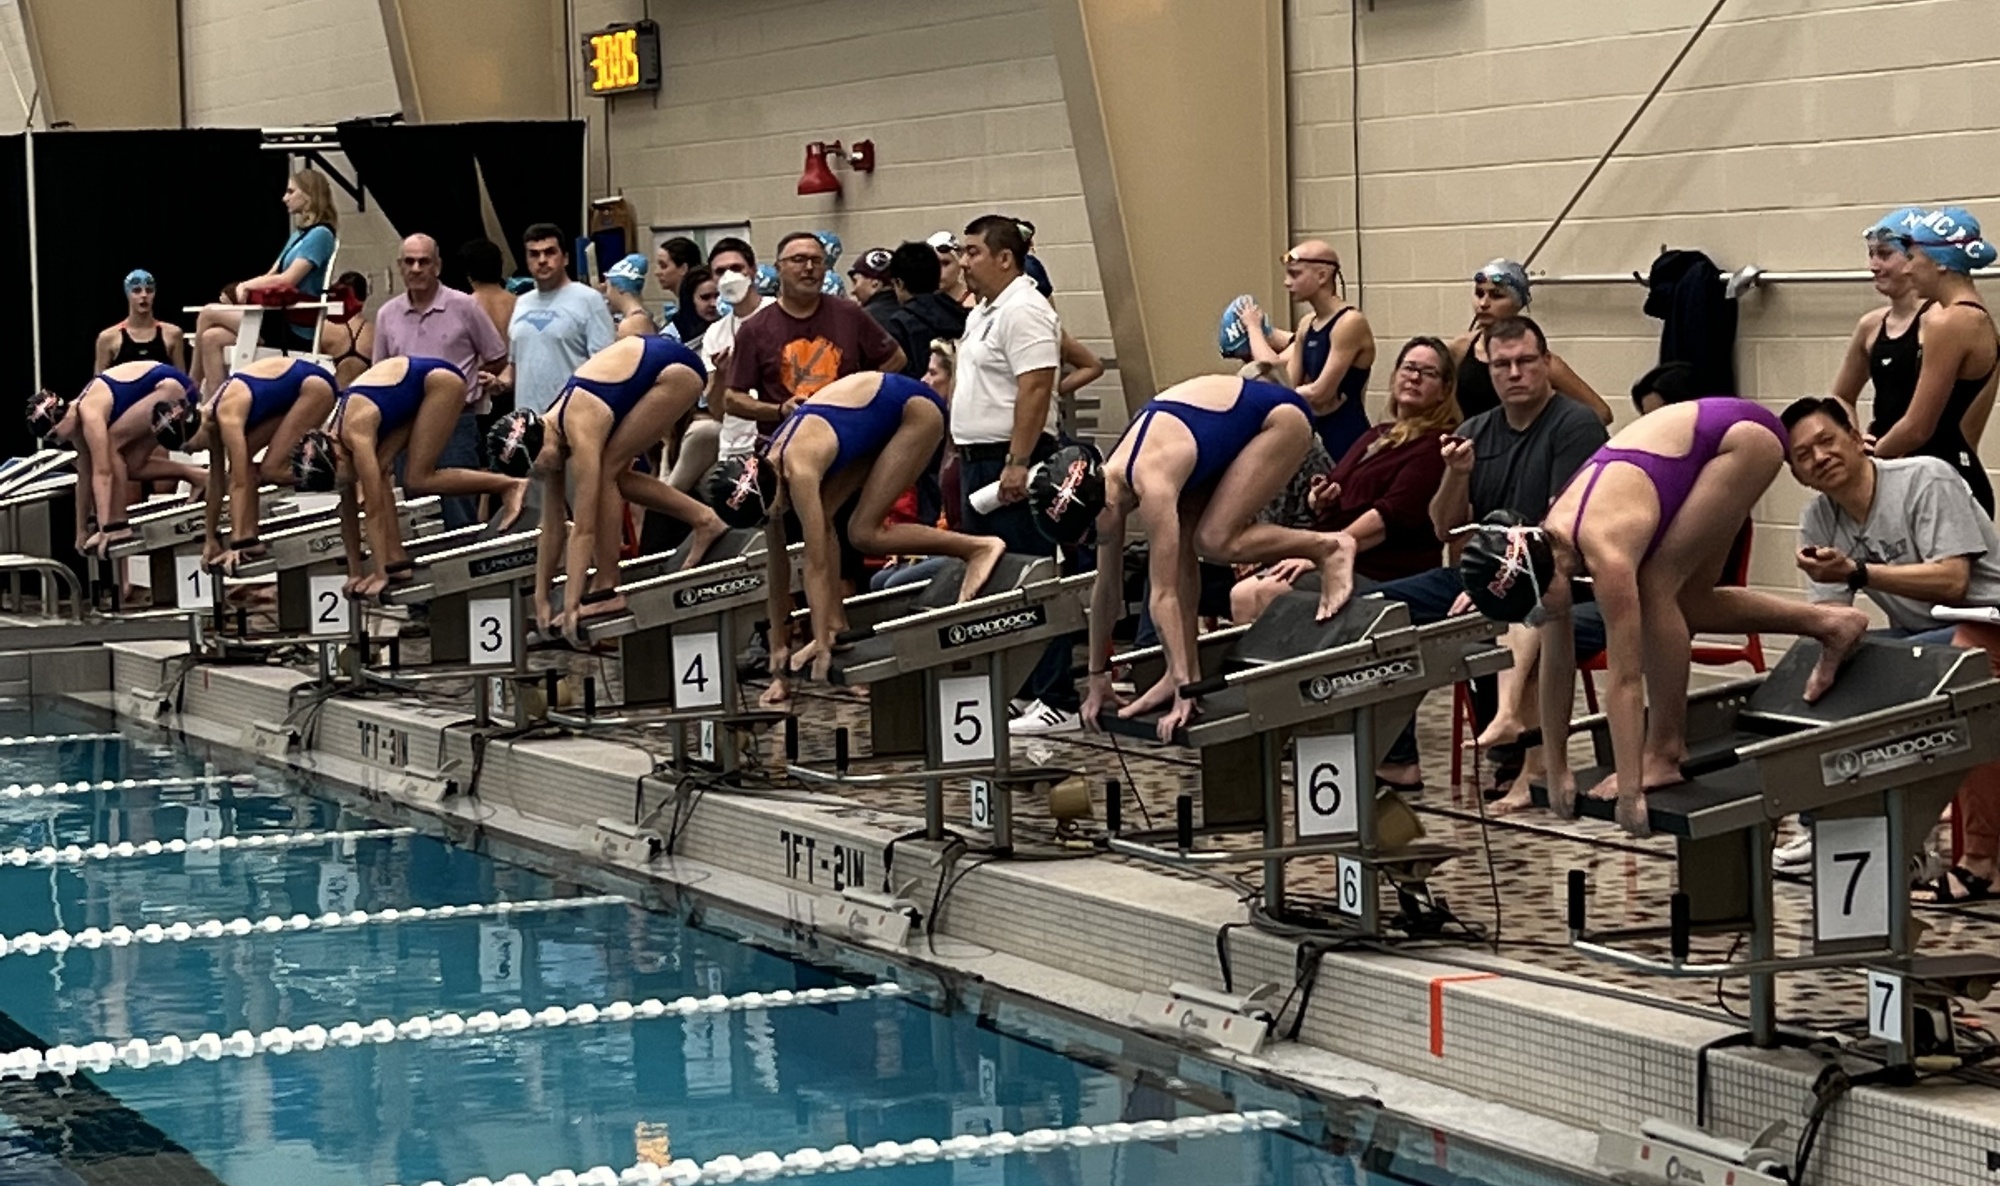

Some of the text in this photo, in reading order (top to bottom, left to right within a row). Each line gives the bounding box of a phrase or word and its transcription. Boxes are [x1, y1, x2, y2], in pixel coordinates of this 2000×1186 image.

[187, 569, 200, 598] 1
[697, 576, 760, 597] PADDOCK
[318, 591, 340, 624] 2
[967, 611, 1038, 637] PADDOCK
[479, 616, 503, 653] 3
[681, 653, 709, 693] 4
[1331, 660, 1413, 689] PADDOCK
[953, 699, 982, 746] 5
[1861, 730, 1957, 765] PADDOCK
[974, 785, 986, 822] 5
[1308, 762, 1342, 816] 6
[1343, 865, 1357, 908] 6
[1832, 850, 1872, 916] 7
[1874, 980, 1895, 1032] 7
